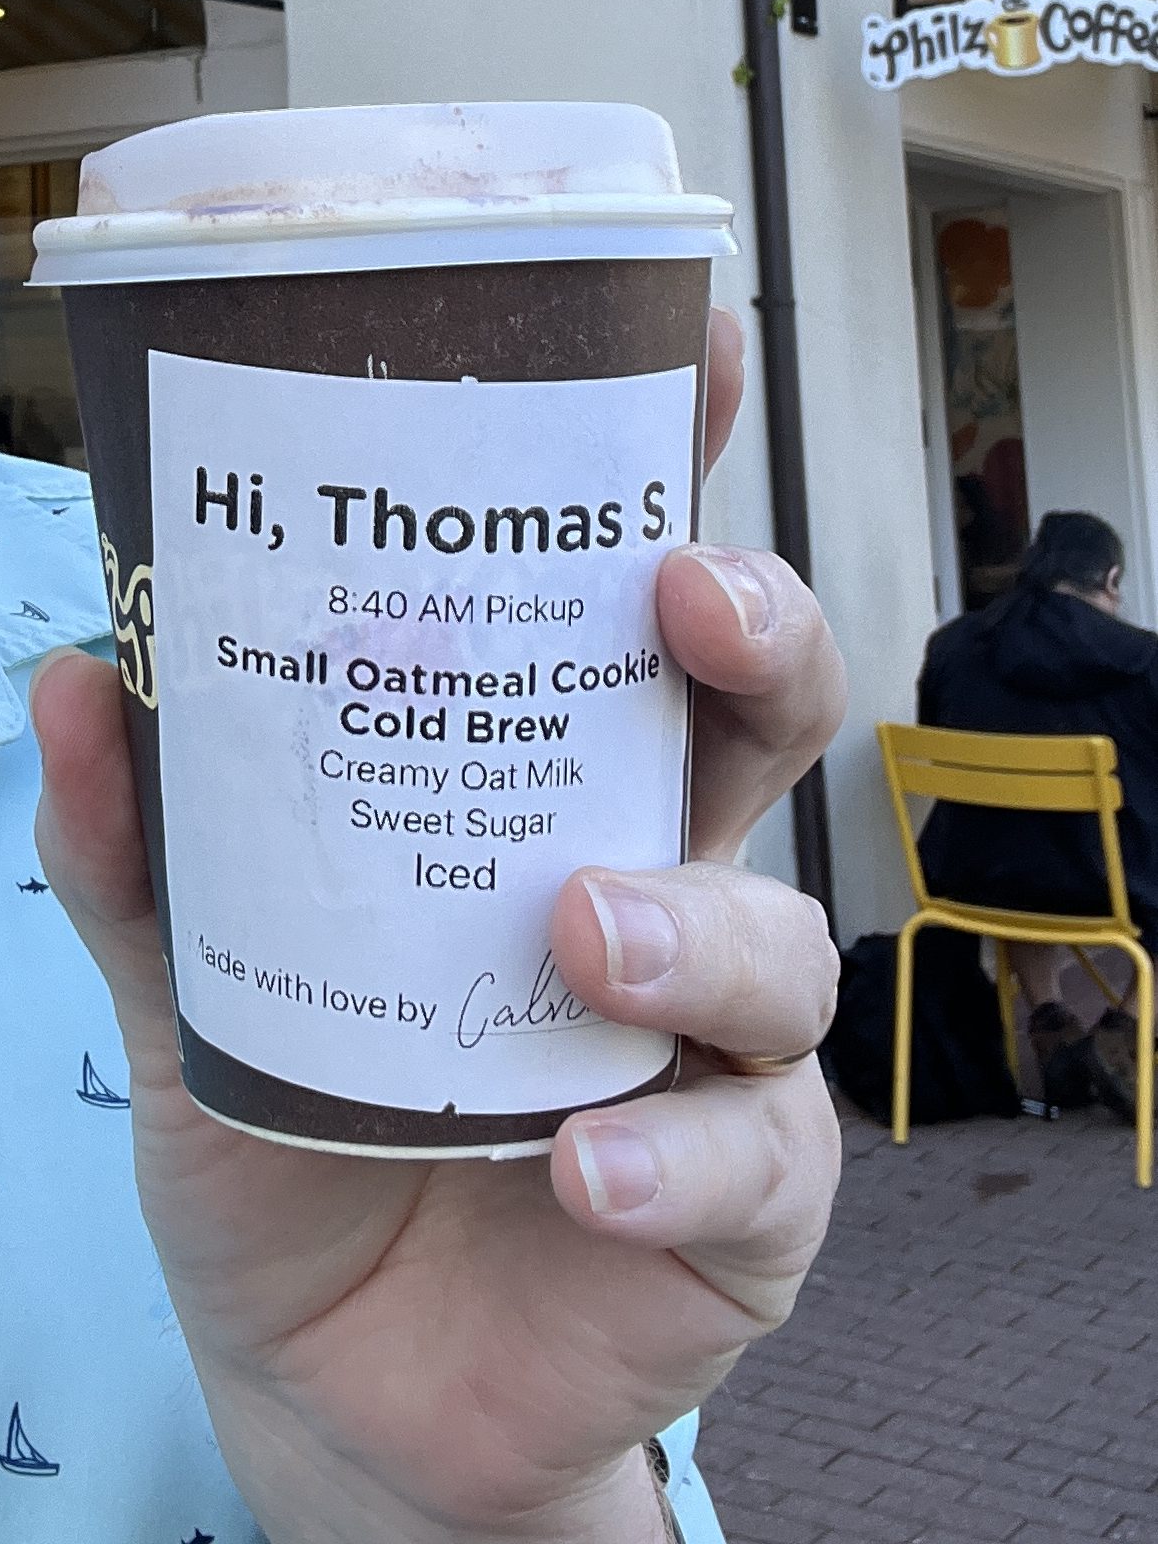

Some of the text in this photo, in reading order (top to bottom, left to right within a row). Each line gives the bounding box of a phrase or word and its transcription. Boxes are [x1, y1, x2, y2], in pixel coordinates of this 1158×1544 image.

[867, 12, 991, 82] Philz
[195, 465, 673, 556] Hi, Thomas S.
[328, 584, 585, 628] 8:40 AM Pickup
[217, 634, 660, 699] Small Oatmeal Cookie
[339, 701, 570, 746] Cold Brew
[320, 748, 585, 796] Creamy Oat Milk
[349, 798, 558, 844] Sweet Sugar
[415, 851, 497, 892] Iced
[254, 966, 313, 1005] with
[322, 979, 387, 1019] love
[397, 992, 438, 1031] by
